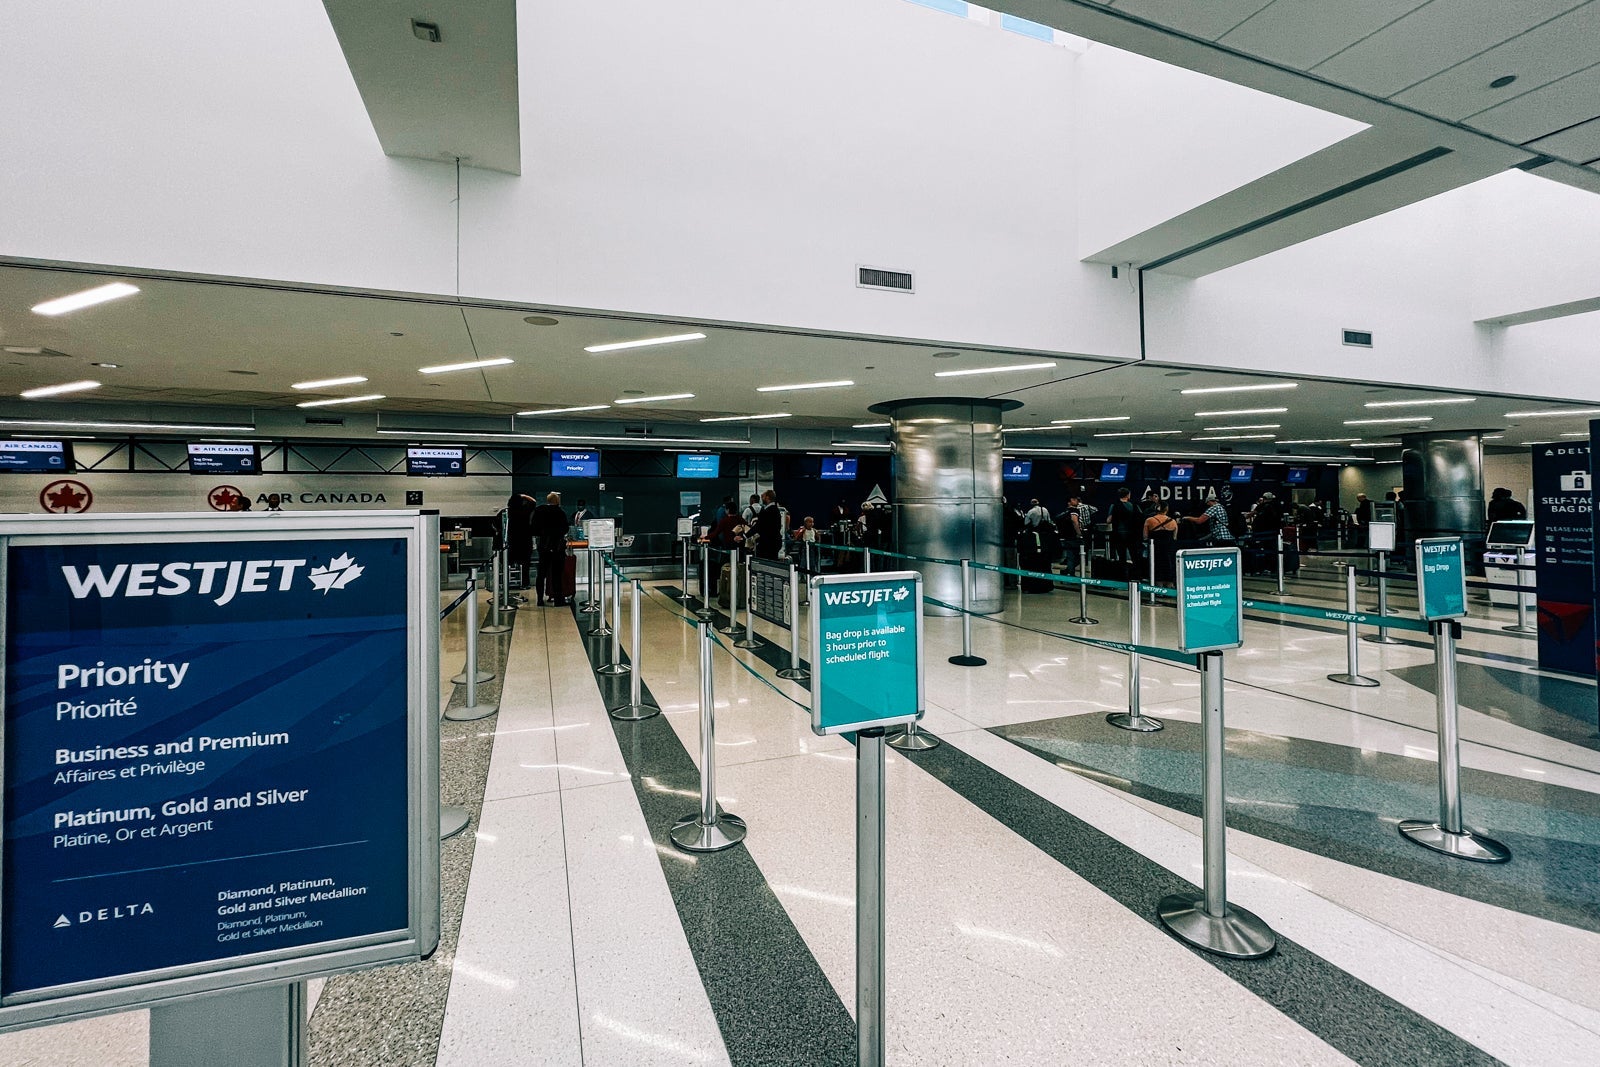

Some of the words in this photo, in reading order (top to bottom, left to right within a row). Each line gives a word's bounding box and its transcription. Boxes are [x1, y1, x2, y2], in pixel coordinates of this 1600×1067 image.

[256, 493, 293, 504] AR
[300, 493, 387, 504] CANADA
[1551, 505, 1576, 513] BAG
[1424, 545, 1450, 554] WESTJET
[1185, 558, 1223, 571] WESTJET
[1424, 564, 1436, 573] Bag
[1436, 563, 1449, 573] Drop
[61, 559, 306, 606] WESTJET
[824, 588, 893, 607] WESTJET
[1186, 600, 1209, 608] scheduled
[1325, 611, 1358, 621] WESTJET
[825, 631, 841, 641] Bag
[843, 629, 861, 639] drop
[863, 628, 870, 636] is
[871, 625, 905, 635] available
[825, 643, 831, 652] 3
[832, 641, 856, 651] hours
[857, 639, 876, 650] prior
[878, 639, 887, 647] to
[825, 651, 867, 664] scheduled
[868, 650, 890, 661] flight
[57, 658, 190, 689] Priority
[56, 696, 137, 720] Priorité
[55, 744, 149, 765] Business
[153, 738, 193, 756] and
[199, 731, 289, 751] Premium
[54, 767, 116, 784] Affaires
[120, 765, 136, 778] et
[140, 760, 205, 776] Privilège
[54, 806, 156, 829] Platinum,
[161, 797, 208, 817] Gold
[213, 792, 251, 811] and
[256, 788, 309, 806] Silver
[53, 831, 111, 848] Platine,
[115, 828, 137, 841] Or
[140, 825, 156, 838] et
[159, 819, 213, 837] Argent
[218, 883, 277, 901] Diamond,
[279, 877, 336, 893] Platinum,
[217, 902, 246, 916] Gold
[248, 898, 272, 911] and
[274, 895, 307, 908] Silver
[310, 886, 367, 902] Medallion
[79, 902, 154, 924] DELTA
[217, 916, 263, 931] Diamond,
[265, 910, 308, 924] Platinum,
[217, 930, 240, 943] Gold
[241, 929, 251, 939] et
[253, 925, 277, 937] Silver
[279, 919, 323, 933] Medallion
